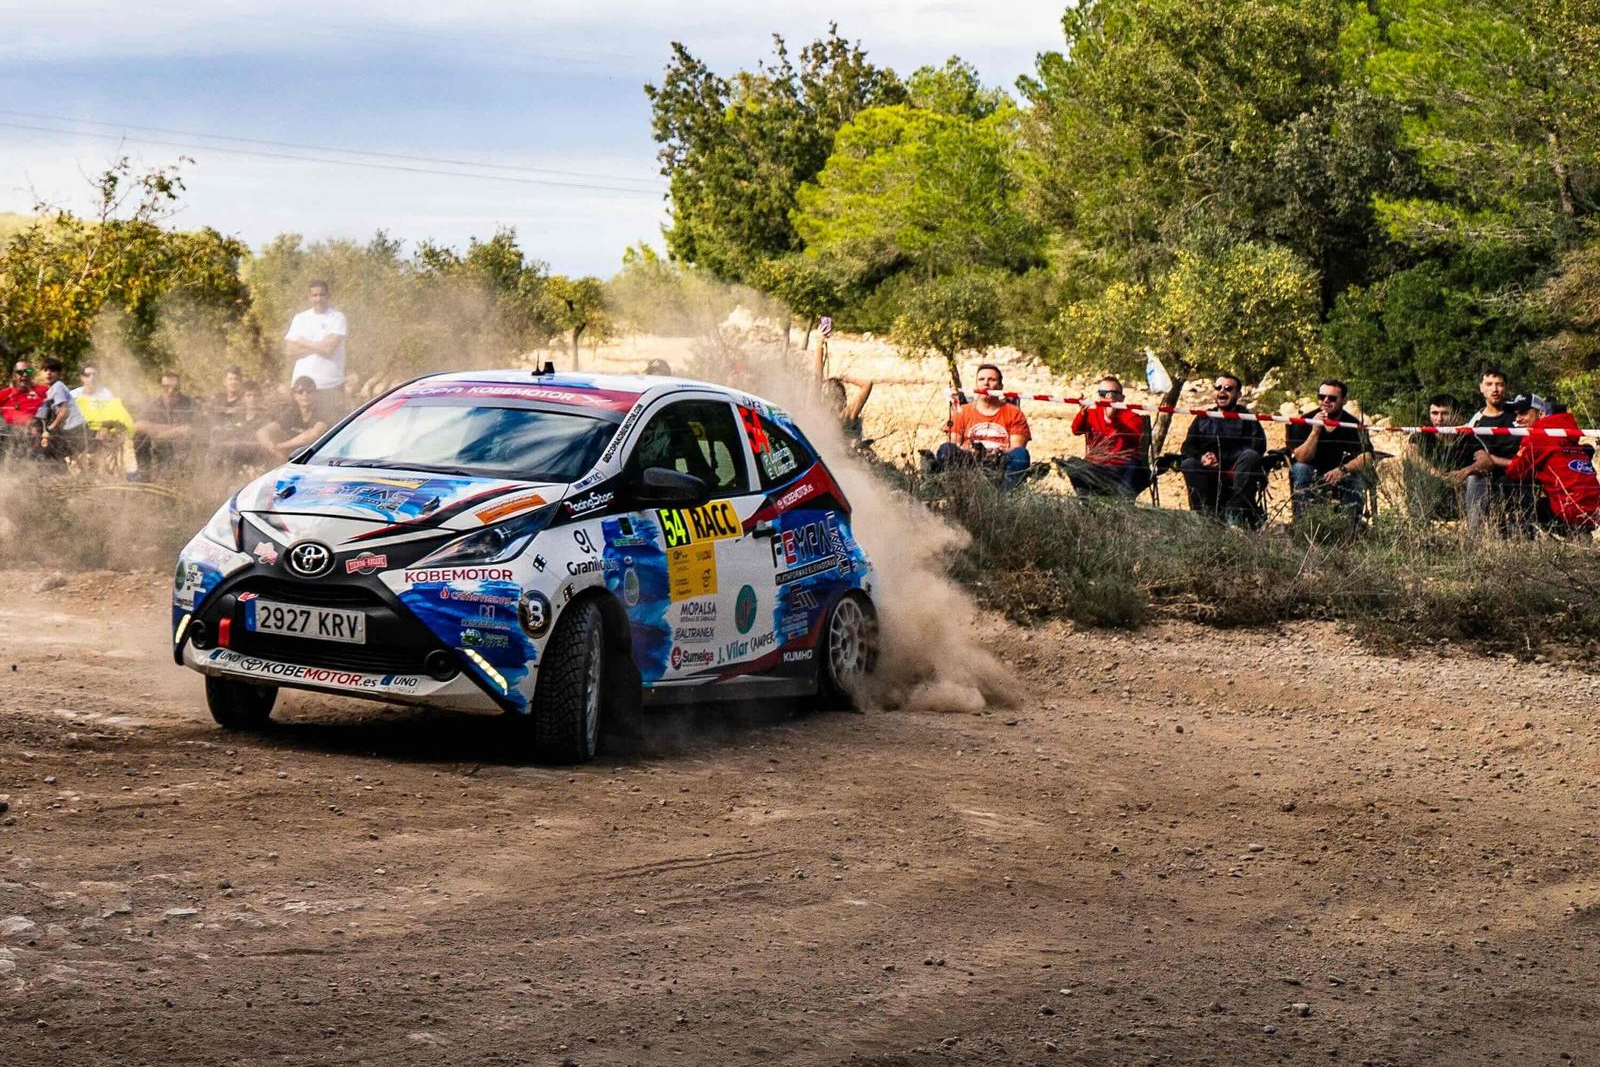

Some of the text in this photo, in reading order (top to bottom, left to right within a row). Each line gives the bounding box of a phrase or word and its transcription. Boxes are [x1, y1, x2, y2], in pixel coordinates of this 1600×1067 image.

[468, 386, 575, 401] KOBEMOTOR
[738, 406, 771, 454] 54
[660, 509, 687, 546] 54
[688, 503, 737, 539] RACC
[405, 568, 513, 583] KOBEMOTOR
[680, 601, 717, 615] MOPALSA
[260, 606, 358, 638] 2927 KRV
[261, 662, 378, 688] KOBEMOTOR.es
[394, 676, 418, 687] UNO
